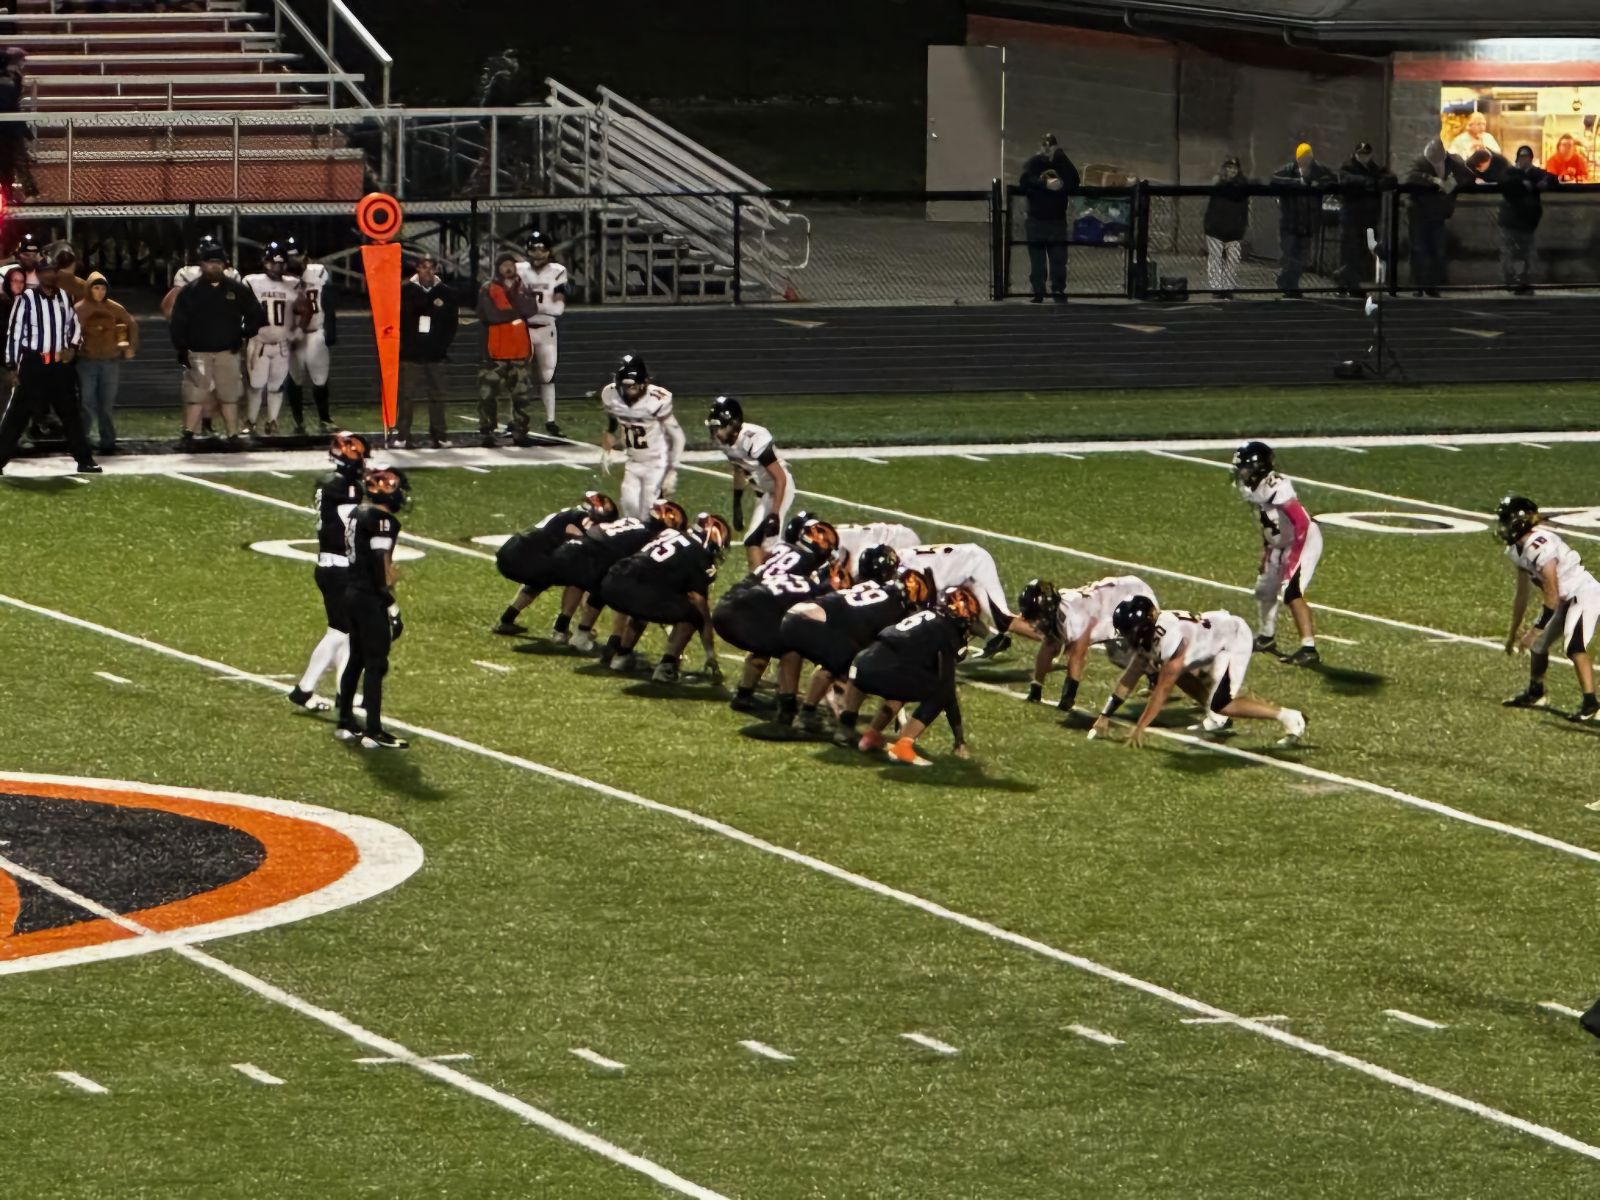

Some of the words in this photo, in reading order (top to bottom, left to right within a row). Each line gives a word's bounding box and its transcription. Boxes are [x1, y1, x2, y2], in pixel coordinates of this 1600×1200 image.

[260, 300, 286, 327] 10
[623, 424, 649, 449] 12
[640, 527, 692, 563] 75
